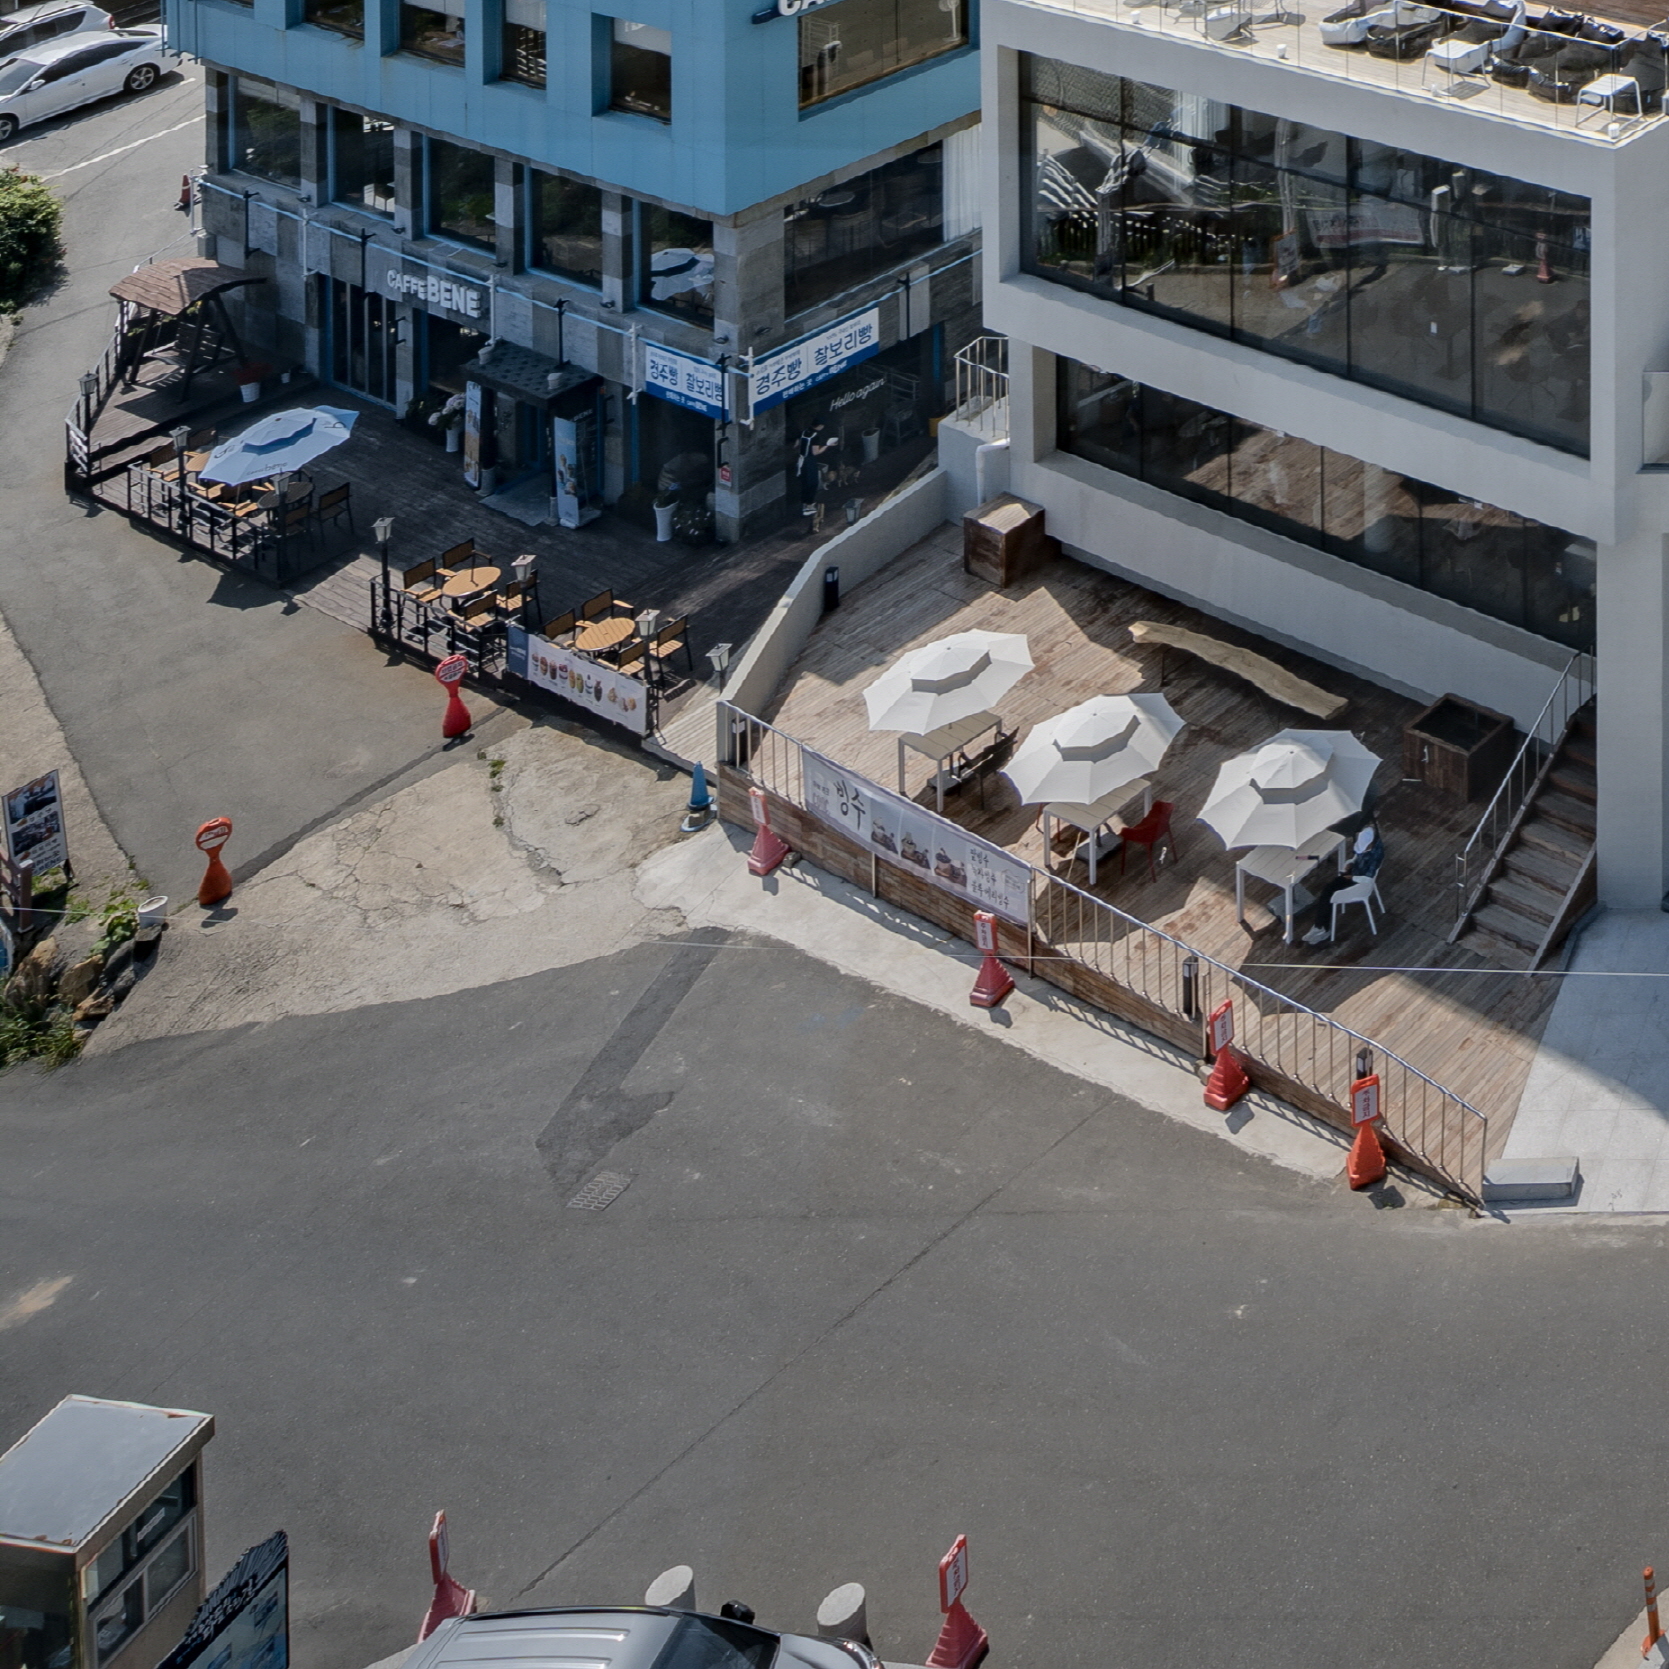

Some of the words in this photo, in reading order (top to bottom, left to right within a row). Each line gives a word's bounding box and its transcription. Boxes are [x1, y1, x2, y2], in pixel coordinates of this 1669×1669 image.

[387, 269, 428, 300] CAFFE
[427, 275, 481, 319] BENE
[815, 324, 873, 365] 찰보리빵
[650, 359, 679, 386] 경주빵
[756, 358, 803, 395] 경주빵
[829, 391, 856, 411] Hello
[833, 779, 866, 831] 빙수
